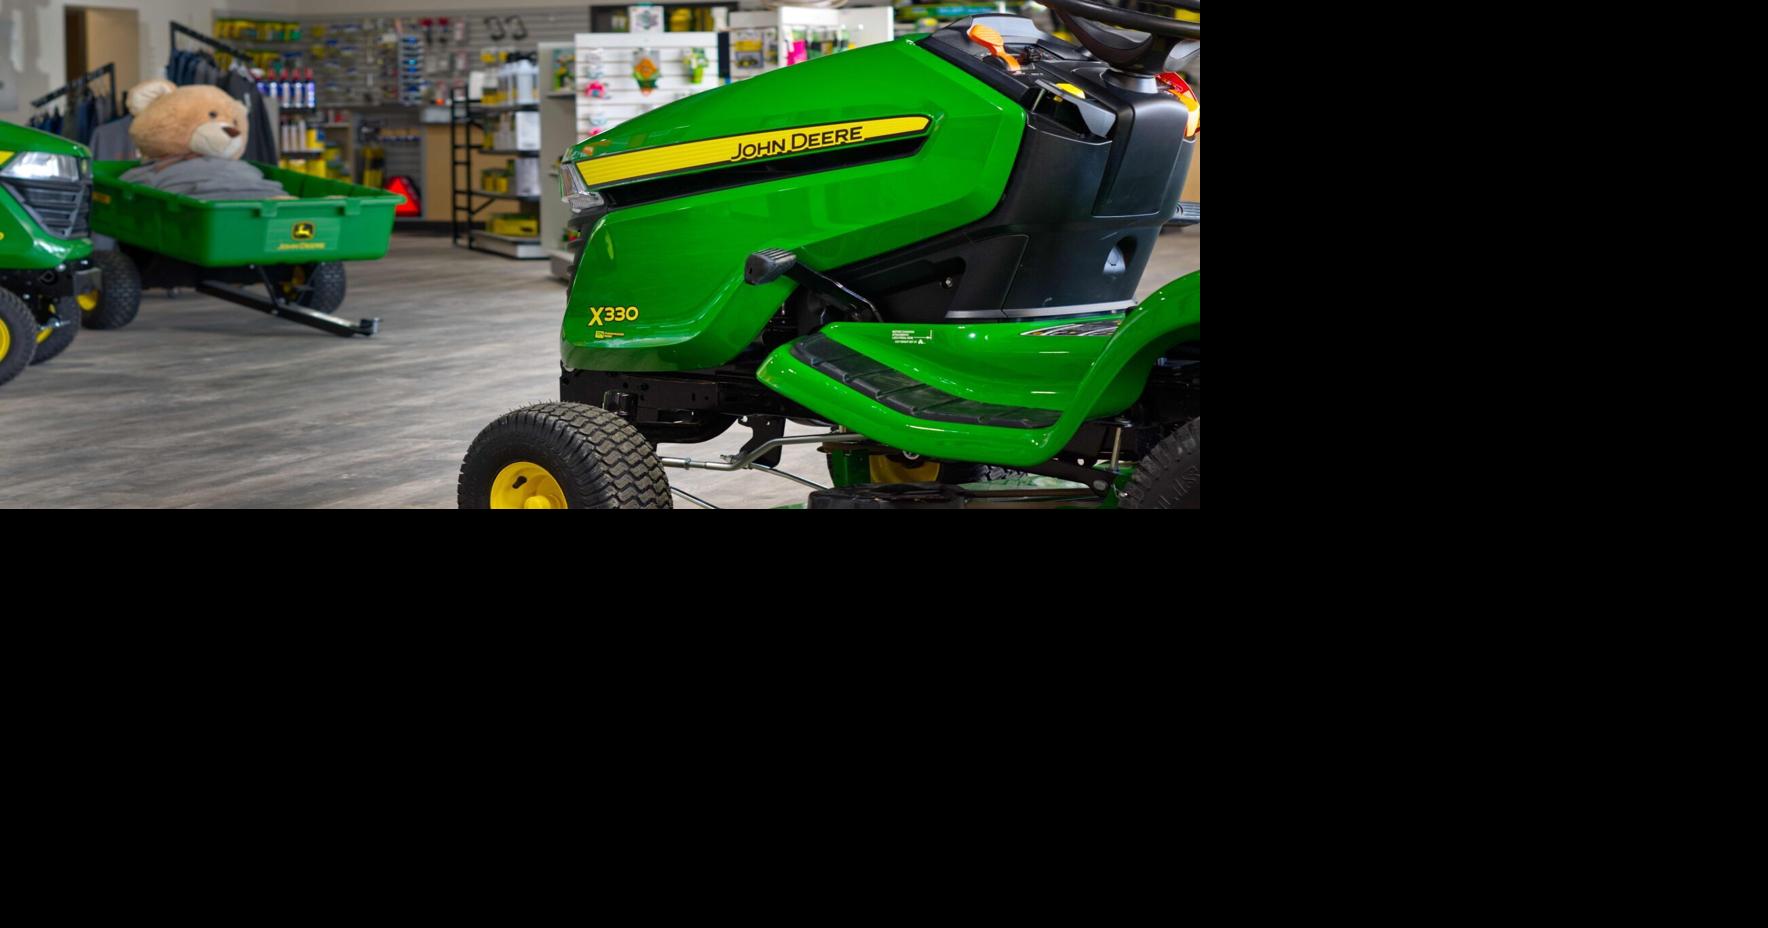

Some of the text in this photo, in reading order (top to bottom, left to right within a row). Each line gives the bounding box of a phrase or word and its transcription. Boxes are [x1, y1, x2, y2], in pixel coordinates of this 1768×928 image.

[731, 126, 863, 160] JOHN DEERE
[588, 306, 639, 326] X330
